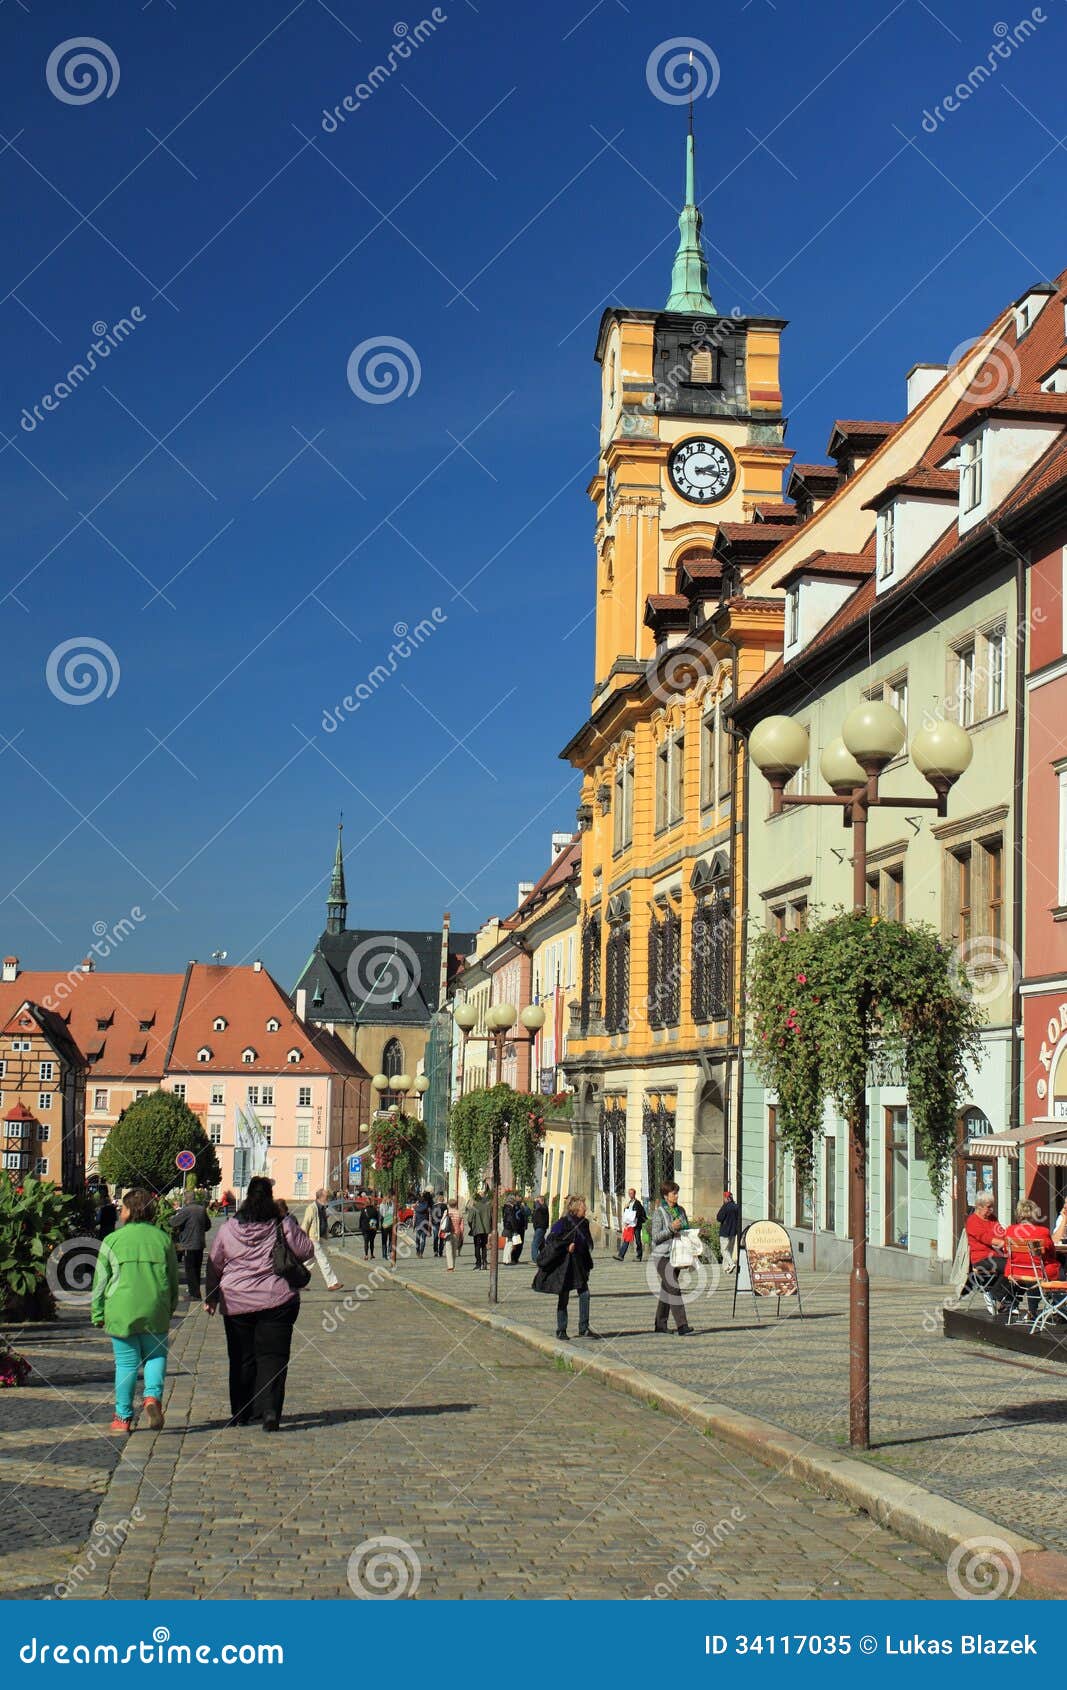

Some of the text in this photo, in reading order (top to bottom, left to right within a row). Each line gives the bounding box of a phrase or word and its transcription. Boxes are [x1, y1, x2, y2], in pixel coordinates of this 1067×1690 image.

[686, 445, 693, 454] 11
[696, 443, 705, 452] 12
[711, 447, 716, 455] 1
[677, 454, 685, 462] 10
[675, 465, 681, 473] 9
[720, 467, 727, 476] 3
[686, 485, 692, 494] 7
[698, 489, 704, 498] 6
[710, 487, 716, 495] 5
